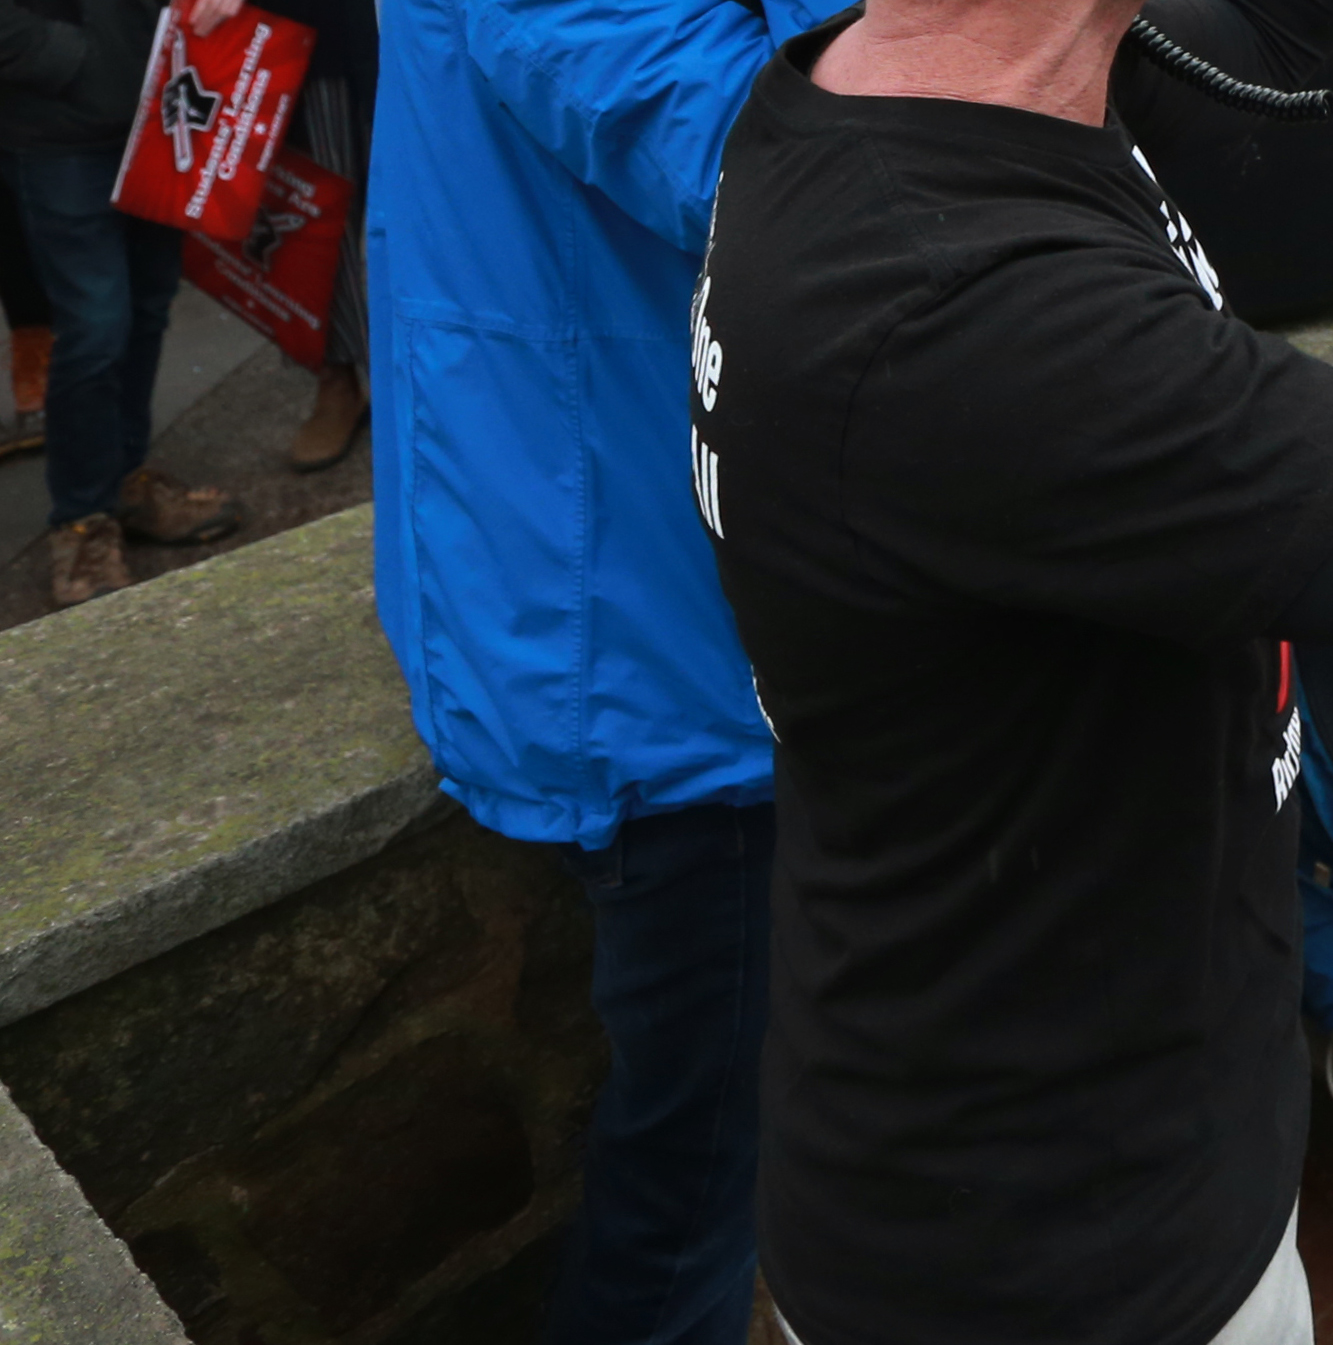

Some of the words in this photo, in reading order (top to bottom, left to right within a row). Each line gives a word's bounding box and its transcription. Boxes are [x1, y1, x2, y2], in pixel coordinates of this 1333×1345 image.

[185, 118, 232, 221] Students'
[223, 21, 273, 117] Learning
[218, 68, 271, 181] Conditions
